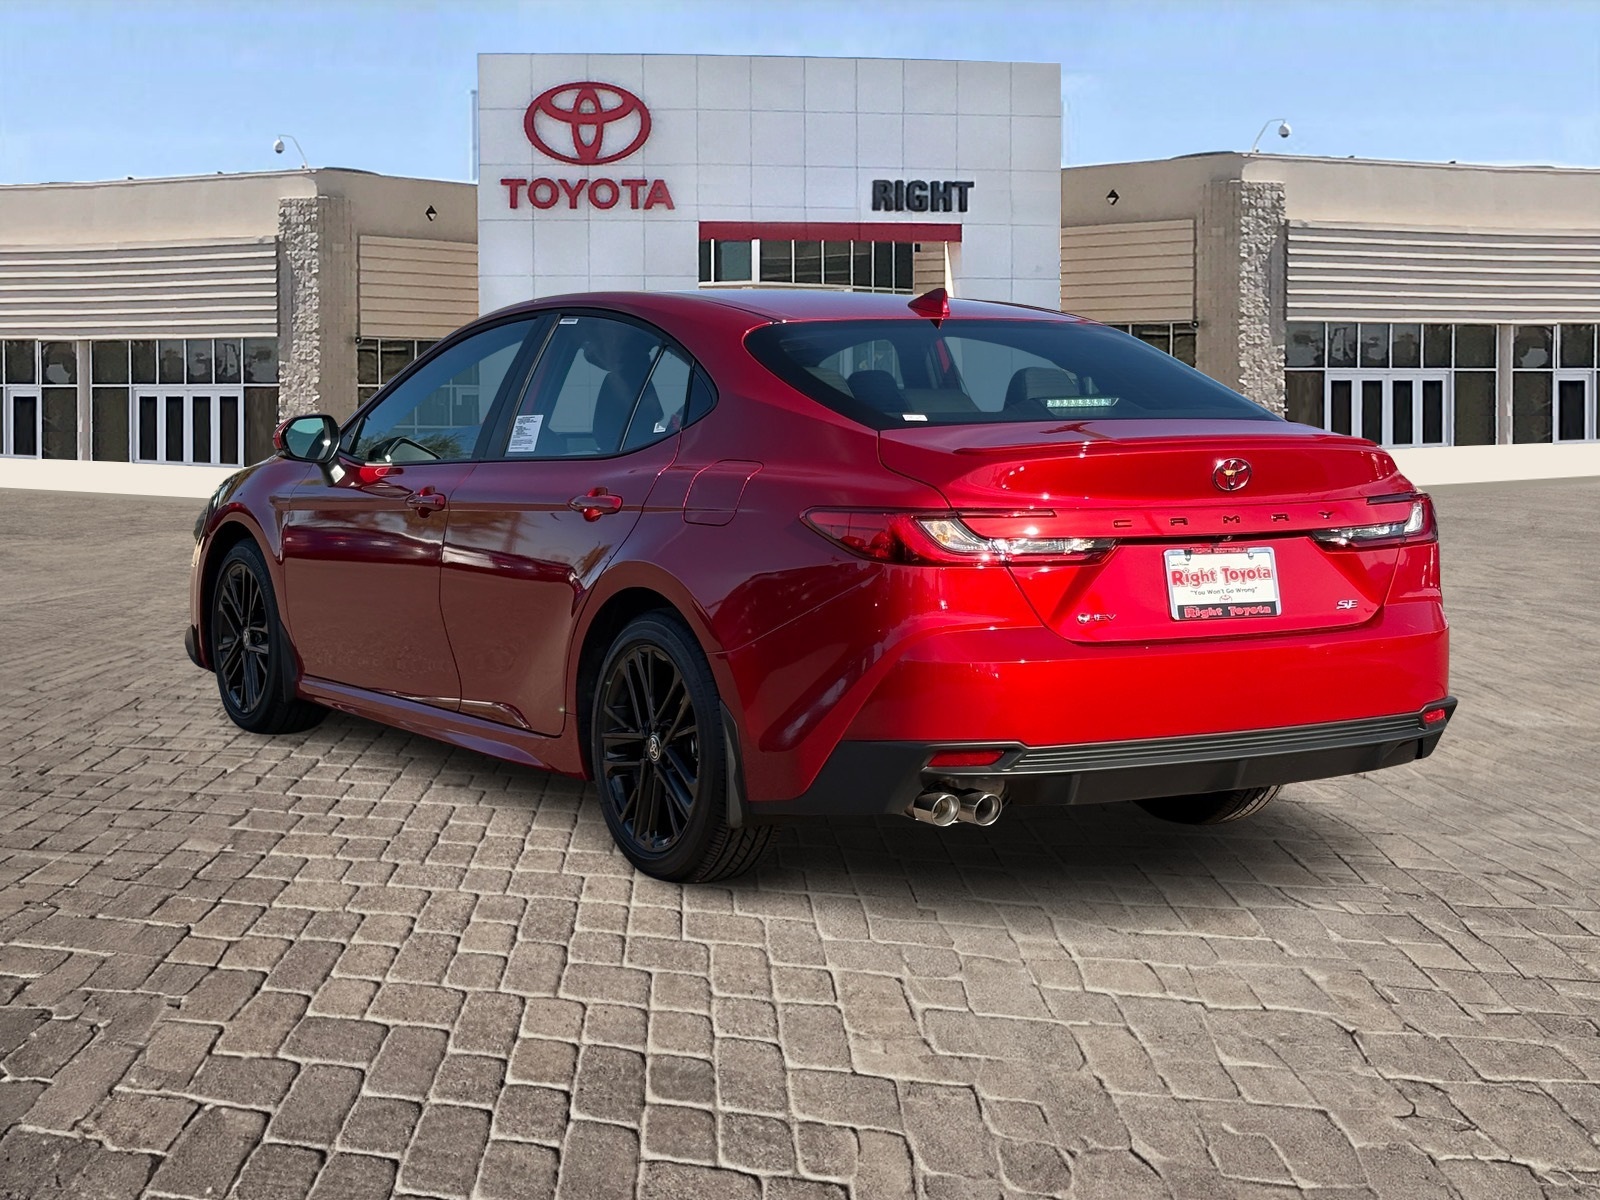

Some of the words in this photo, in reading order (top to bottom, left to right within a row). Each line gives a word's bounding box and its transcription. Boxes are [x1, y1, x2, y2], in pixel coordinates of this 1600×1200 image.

[500, 177, 675, 210] TOYOTA
[872, 179, 975, 212] RIGHT
[1113, 510, 1335, 528] CAMRY
[1171, 568, 1217, 587] Right
[1221, 565, 1272, 585] Toyota
[1184, 606, 1223, 619] Right
[1228, 605, 1272, 617] Toyota
[1336, 599, 1359, 610] SE
